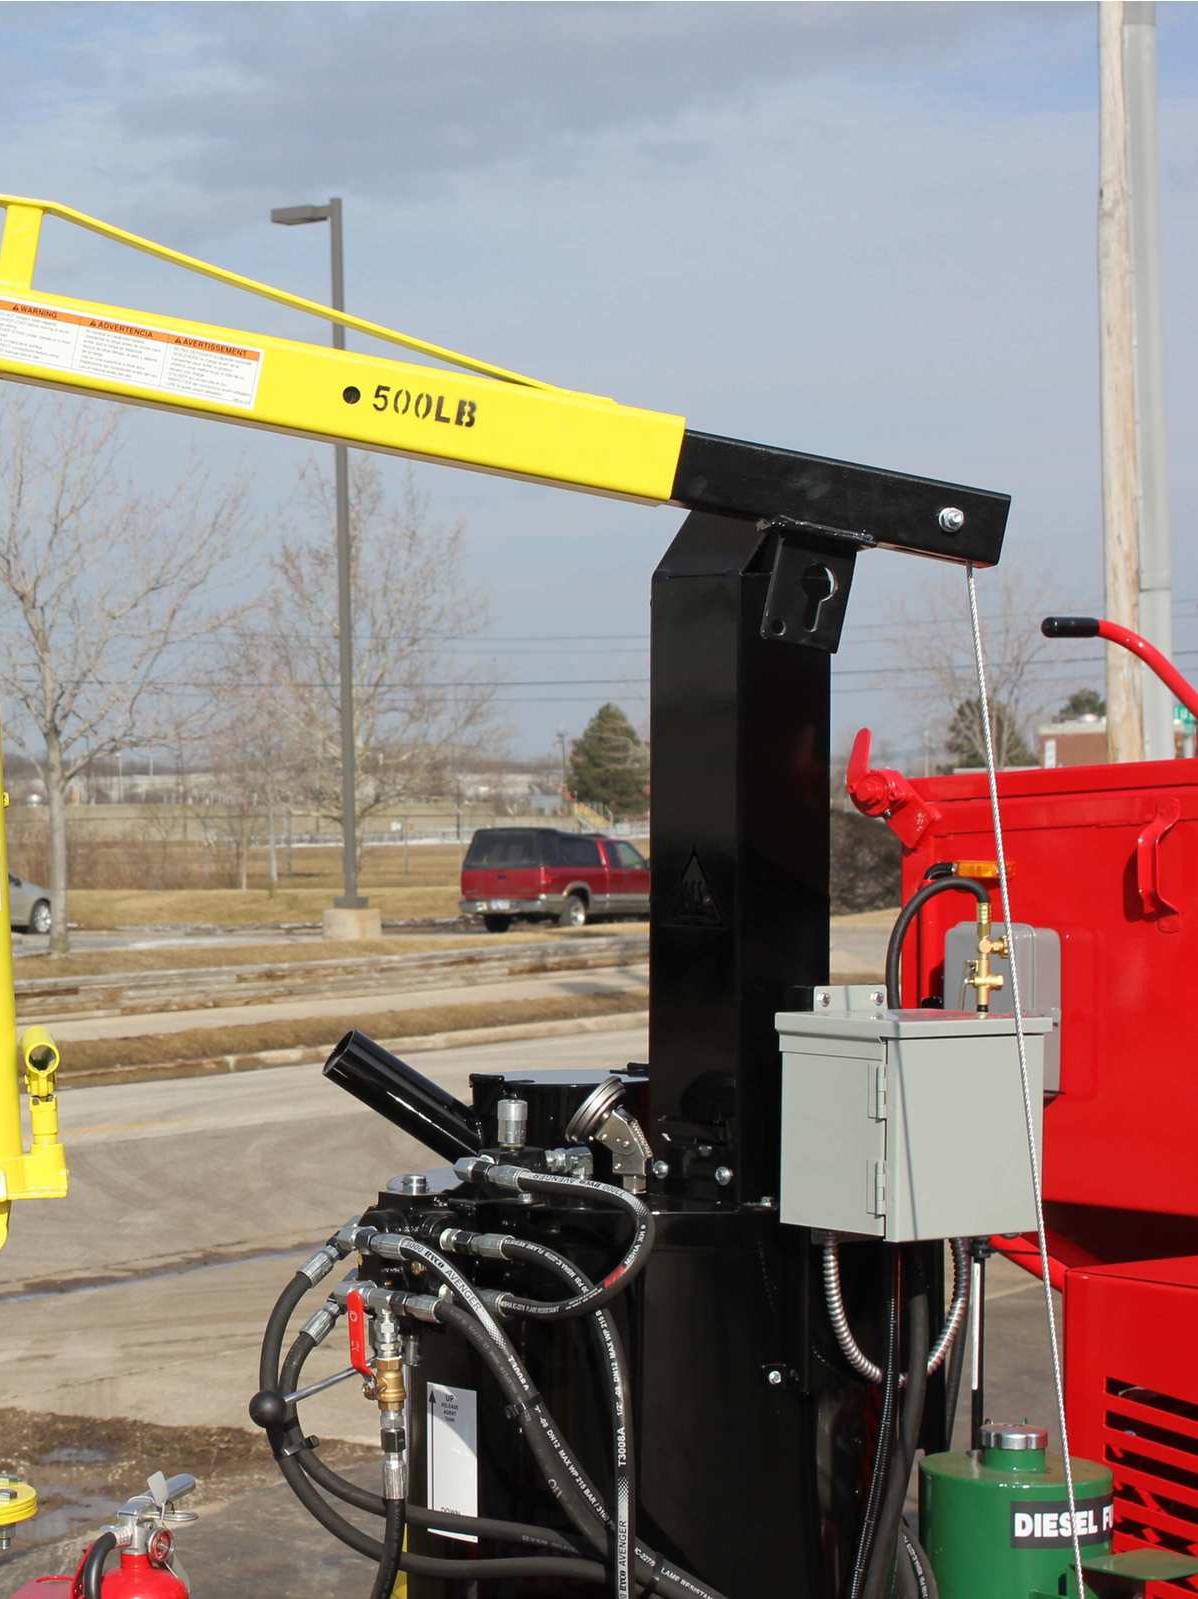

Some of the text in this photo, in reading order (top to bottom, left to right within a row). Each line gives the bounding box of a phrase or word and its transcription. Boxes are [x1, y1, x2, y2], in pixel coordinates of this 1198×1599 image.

[20, 304, 58, 320] WARNING
[97, 320, 154, 339] ADVERTENCIA
[182, 337, 248, 358] AVERTISSEMENT
[372, 384, 478, 428] 500LB
[445, 1269, 483, 1312] AVENGER
[602, 1328, 612, 1342] WP
[607, 1341, 617, 1359] MAX
[610, 1361, 620, 1383] DN12
[445, 1393, 454, 1402] UP
[617, 1426, 627, 1468] T3008A
[546, 1428, 561, 1449] DN12
[558, 1449, 572, 1467] MAX
[568, 1464, 580, 1478] WP
[582, 1488, 597, 1505] BAR
[1014, 1509, 1098, 1538] DIESEL
[618, 1520, 628, 1567] AVENGER
[660, 1567, 681, 1582] LAME
